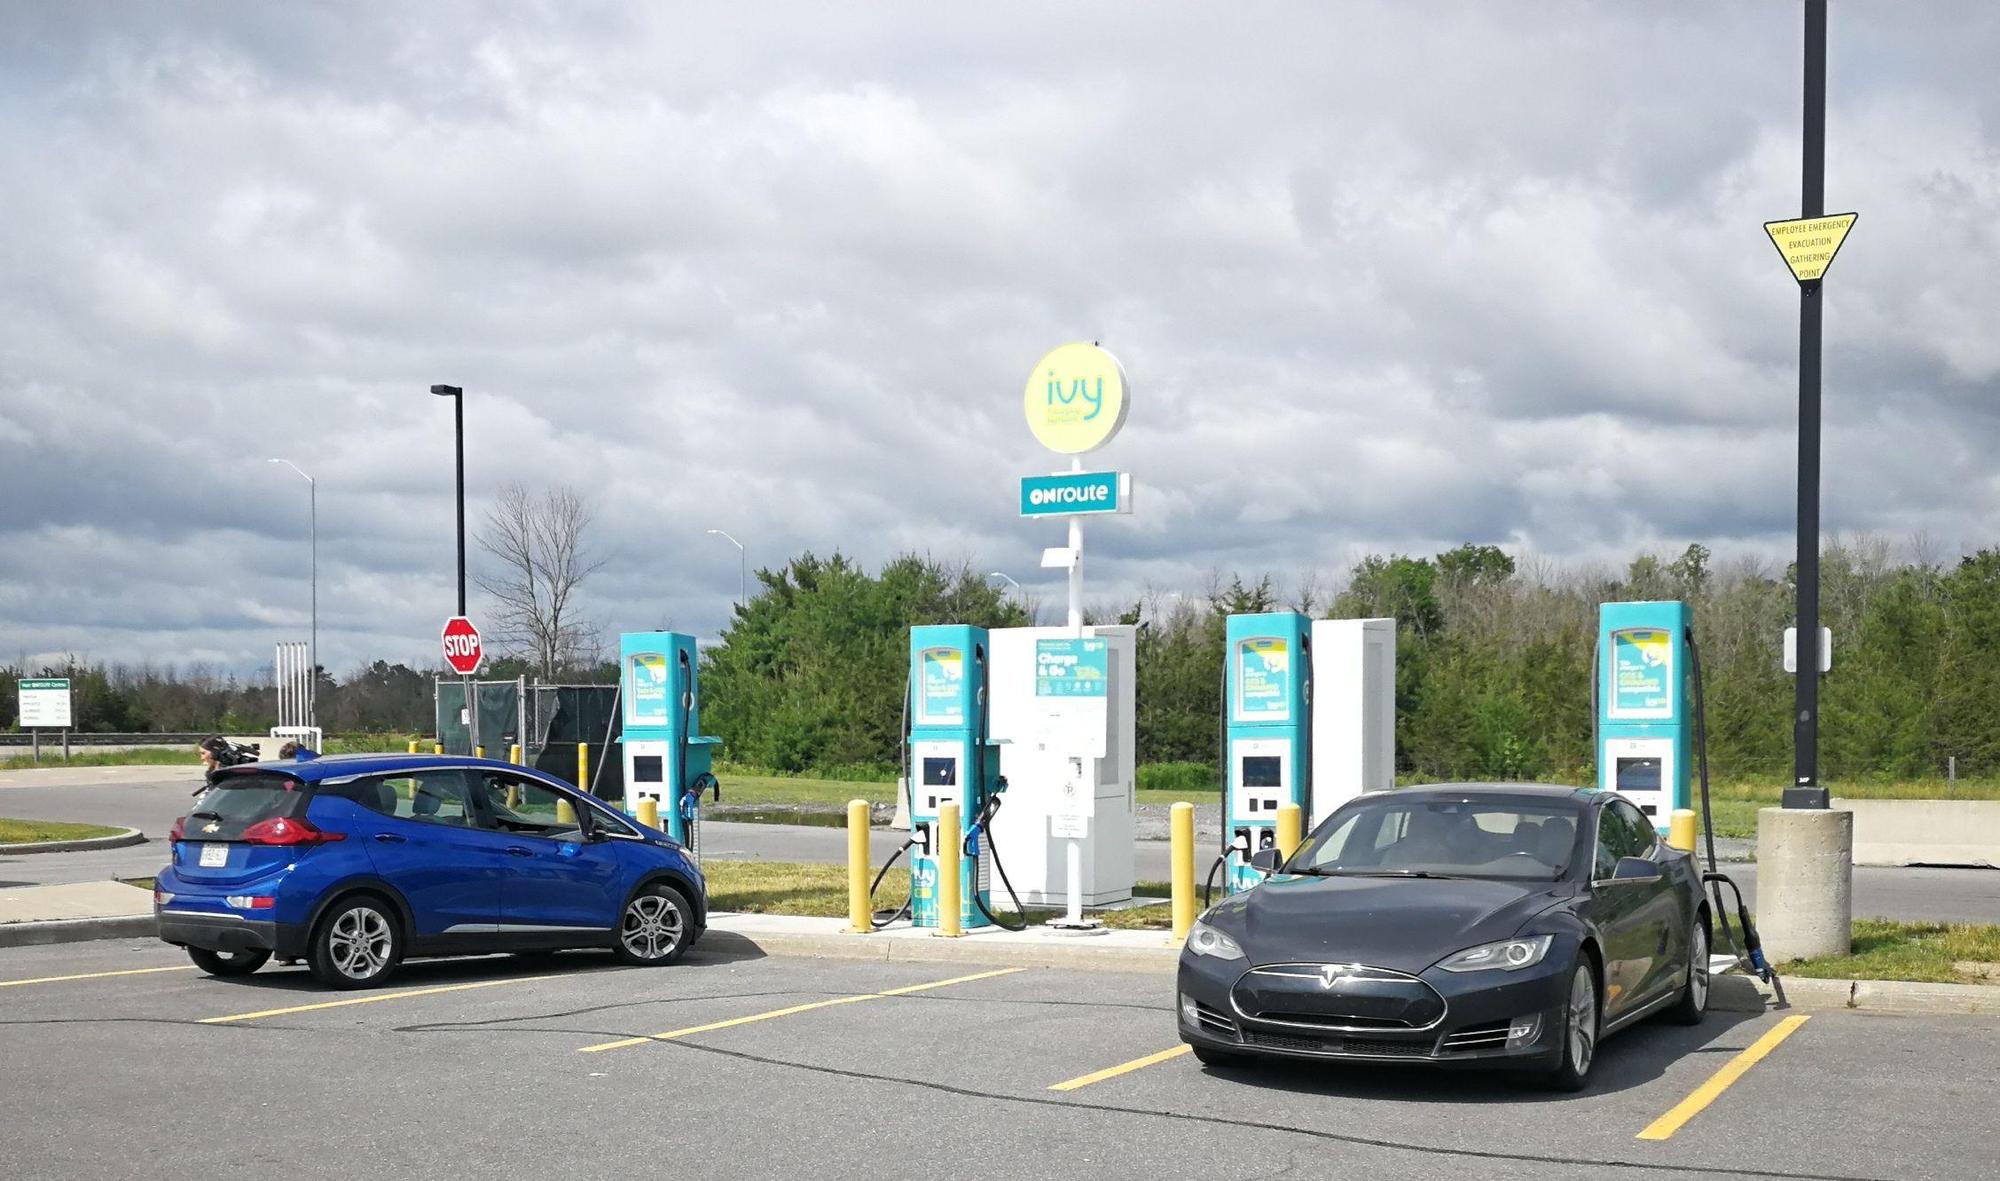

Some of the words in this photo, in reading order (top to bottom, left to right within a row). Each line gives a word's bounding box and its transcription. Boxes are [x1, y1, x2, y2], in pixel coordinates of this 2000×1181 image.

[1772, 225, 1806, 235] EMPLOYEE
[1809, 220, 1849, 231] EMERGENCY
[1789, 237, 1831, 248] EVACUATION
[1791, 253, 1830, 263] GATHERING
[1800, 269, 1820, 278] POINT
[1047, 370, 1102, 421] ivy
[445, 634, 477, 656] STOP
